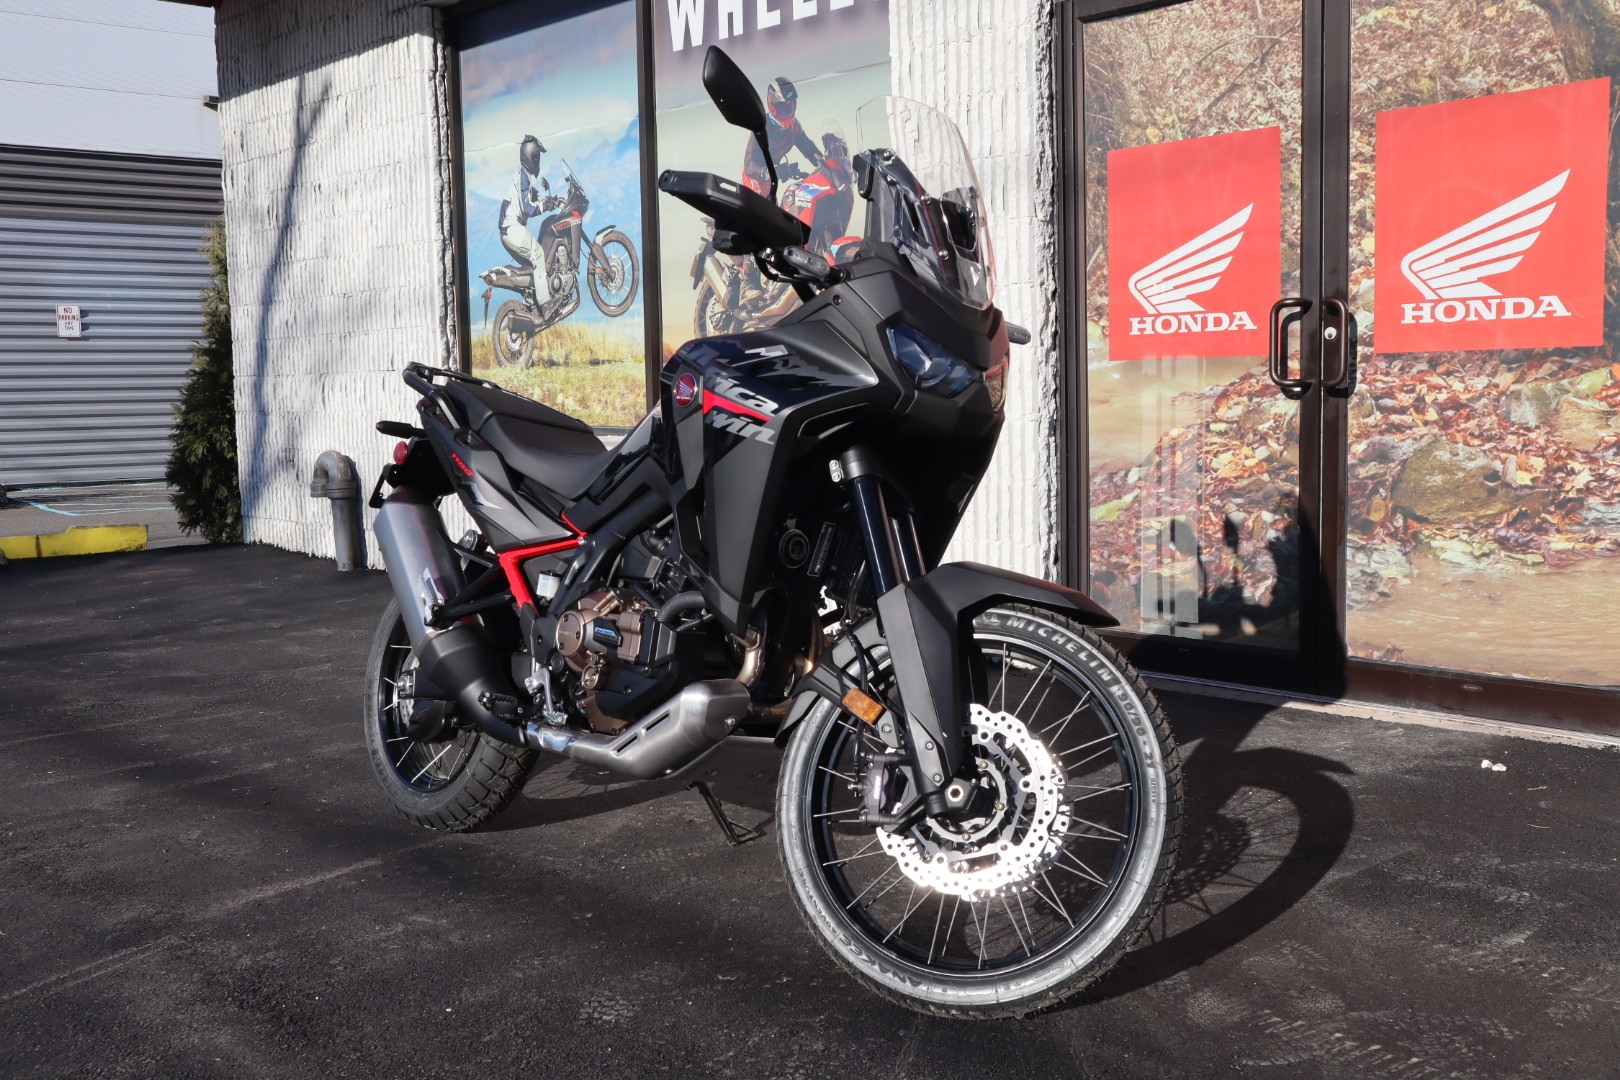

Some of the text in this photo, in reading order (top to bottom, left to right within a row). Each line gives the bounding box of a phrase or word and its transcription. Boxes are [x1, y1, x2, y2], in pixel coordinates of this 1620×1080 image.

[1128, 311, 1258, 336] HONDA
[1400, 295, 1572, 324] HONDA
[1006, 616, 1114, 682] MICHELIN
[839, 933, 923, 988] ANAKEE
